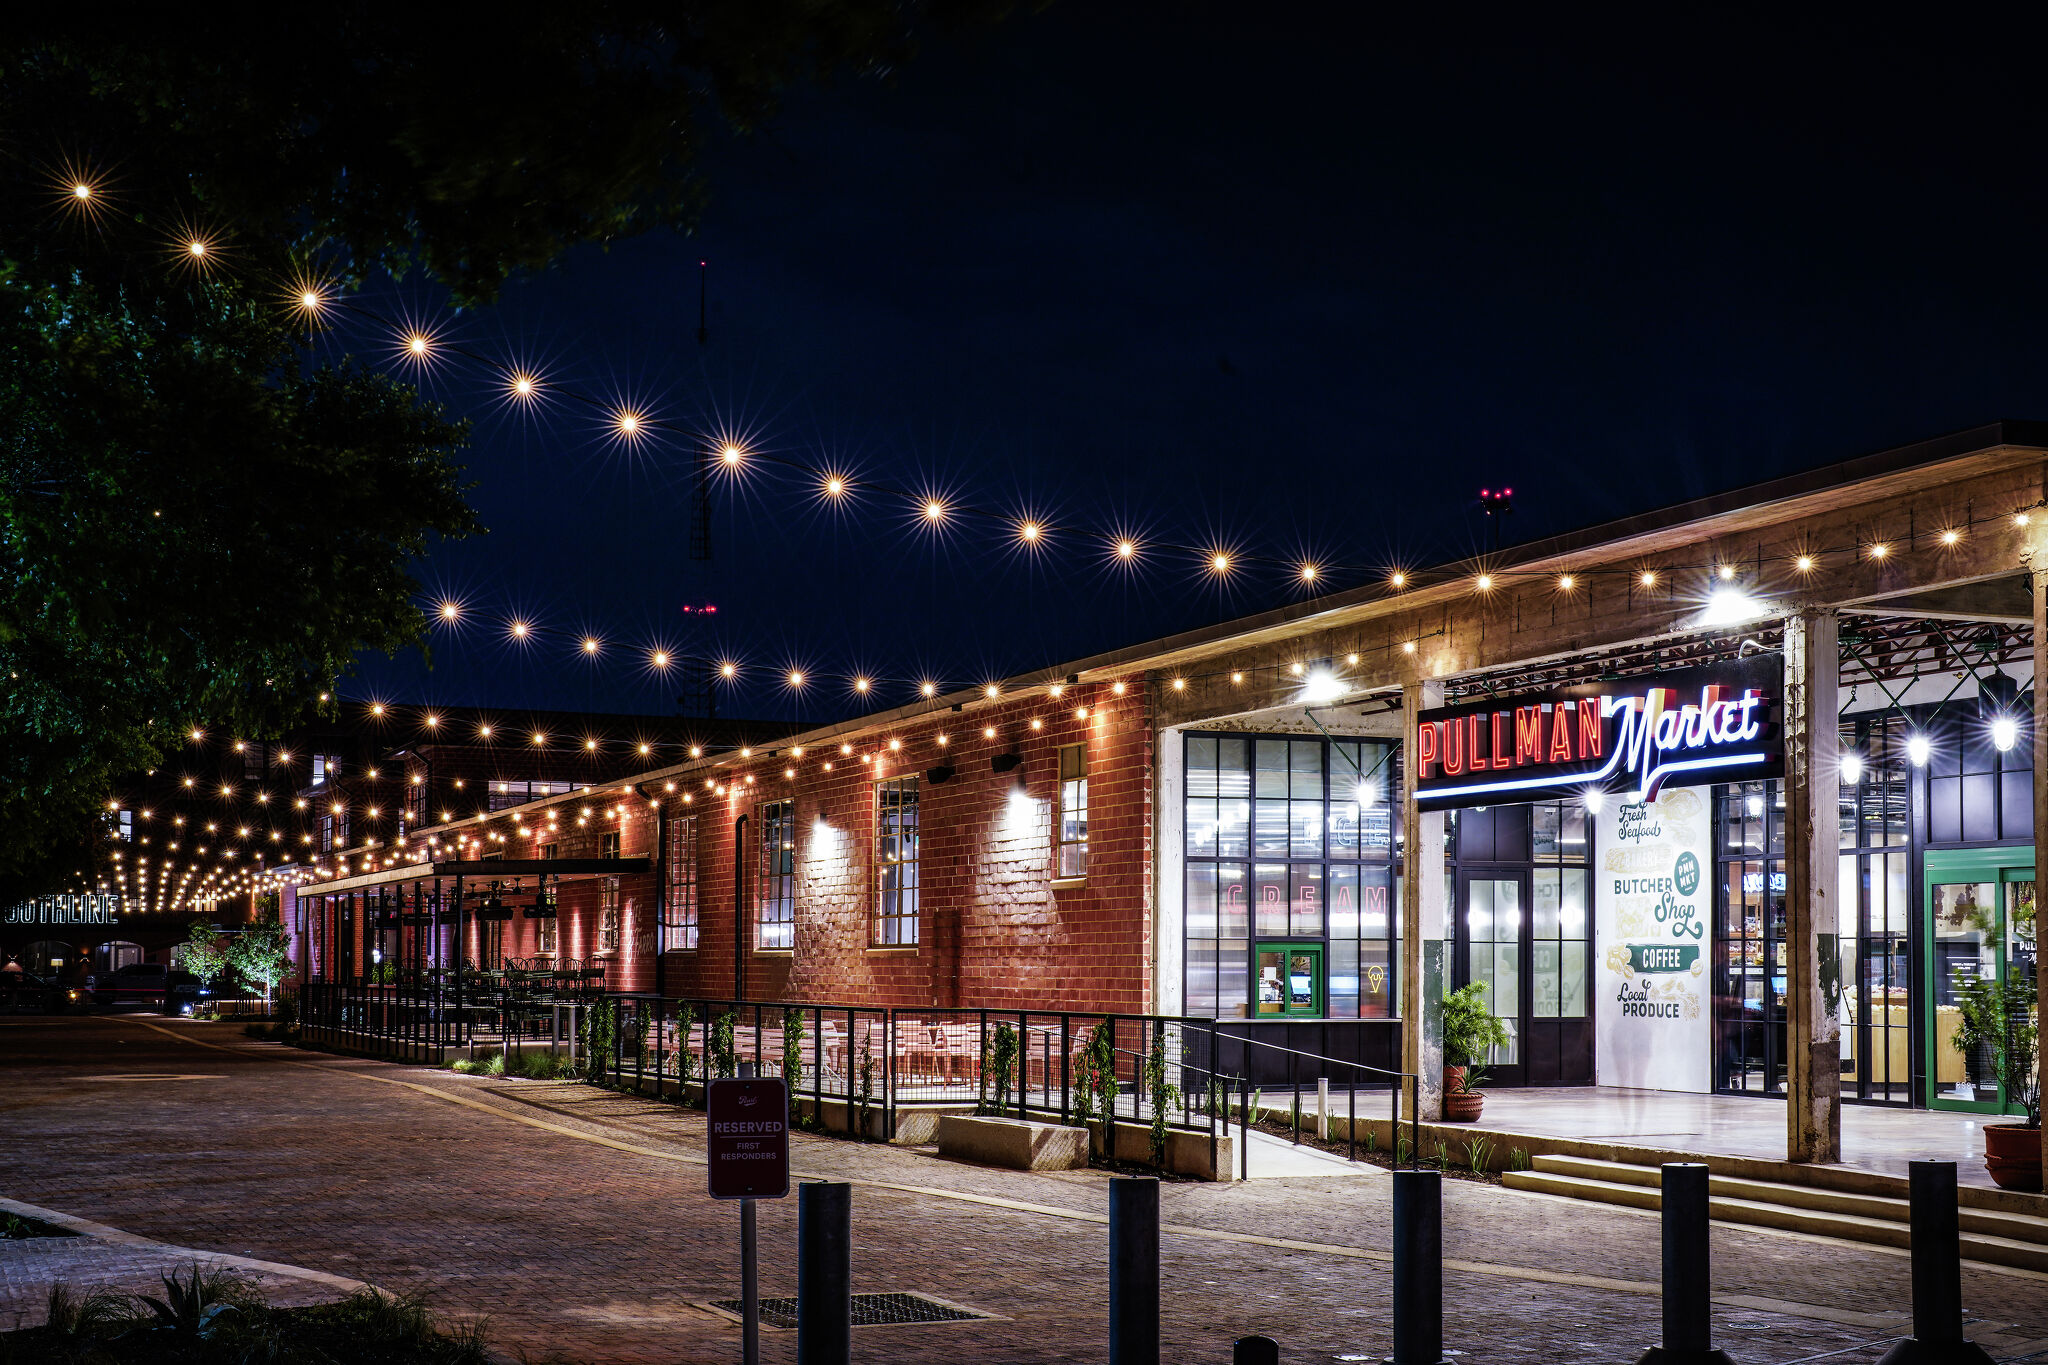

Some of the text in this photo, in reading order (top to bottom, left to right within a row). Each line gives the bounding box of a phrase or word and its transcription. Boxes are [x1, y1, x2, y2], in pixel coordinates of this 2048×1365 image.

[1418, 686, 1762, 799] PULLMAN Market
[1618, 801, 1648, 823] Fresh
[1303, 817, 1384, 846] ICE
[1618, 820, 1661, 844] Seafood
[1615, 877, 1672, 895] BUTCHER
[1227, 885, 1387, 914] CREAM
[1654, 891, 1703, 940] Shop
[1643, 948, 1681, 968] COFFEE
[1616, 979, 1651, 1002] Local
[1623, 1001, 1680, 1019] PRODUCE
[714, 1121, 782, 1133] RESERVED
[721, 1152, 777, 1160] RESPONDERS
[737, 1142, 760, 1150] FIRST
